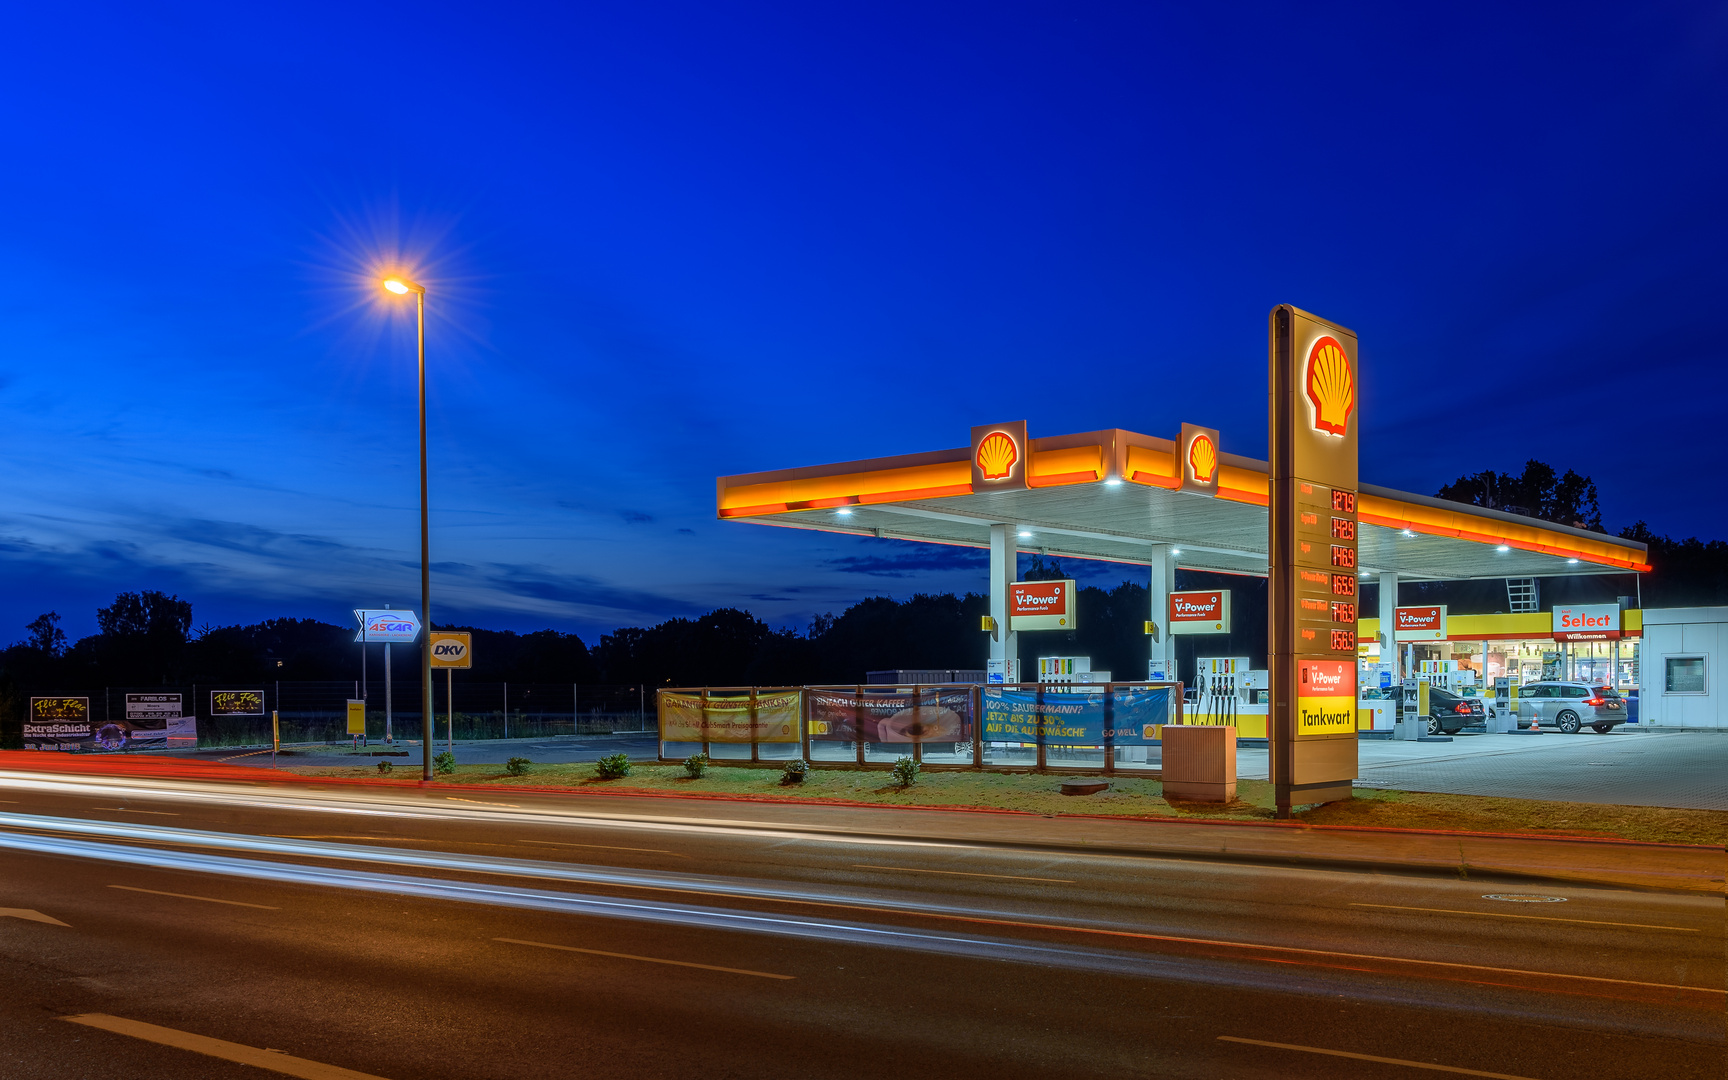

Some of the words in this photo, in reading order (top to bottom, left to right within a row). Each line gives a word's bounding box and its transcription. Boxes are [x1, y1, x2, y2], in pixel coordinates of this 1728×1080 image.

[1015, 594, 1059, 605] V-Power
[1175, 602, 1215, 612] V-Power
[1399, 615, 1435, 624] V-Power
[1561, 613, 1611, 628] Select
[369, 623, 413, 632] ASCAR
[434, 645, 465, 655] DKV
[1311, 672, 1341, 684] V-Power
[214, 692, 235, 706] Flic
[714, 698, 750, 710] GÜNSTIG
[816, 697, 848, 707] EINFACH
[850, 699, 874, 708] GUTER
[876, 699, 905, 708] KAFFEE
[34, 699, 57, 713] Flic
[986, 700, 1010, 712] 100%
[1011, 703, 1084, 715] SAUBERMANN?
[986, 711, 1009, 722] JETZT
[1010, 712, 1025, 723] BIS
[1026, 713, 1040, 725] ZU
[1043, 716, 1065, 726] 50%
[1302, 707, 1350, 726] Tankwart
[23, 724, 91, 733] ExtraSchicht
[986, 723, 1003, 733] AUF
[1004, 724, 1019, 735] DIE
[1102, 728, 1115, 738] GO
[1117, 728, 1138, 737] WELL
